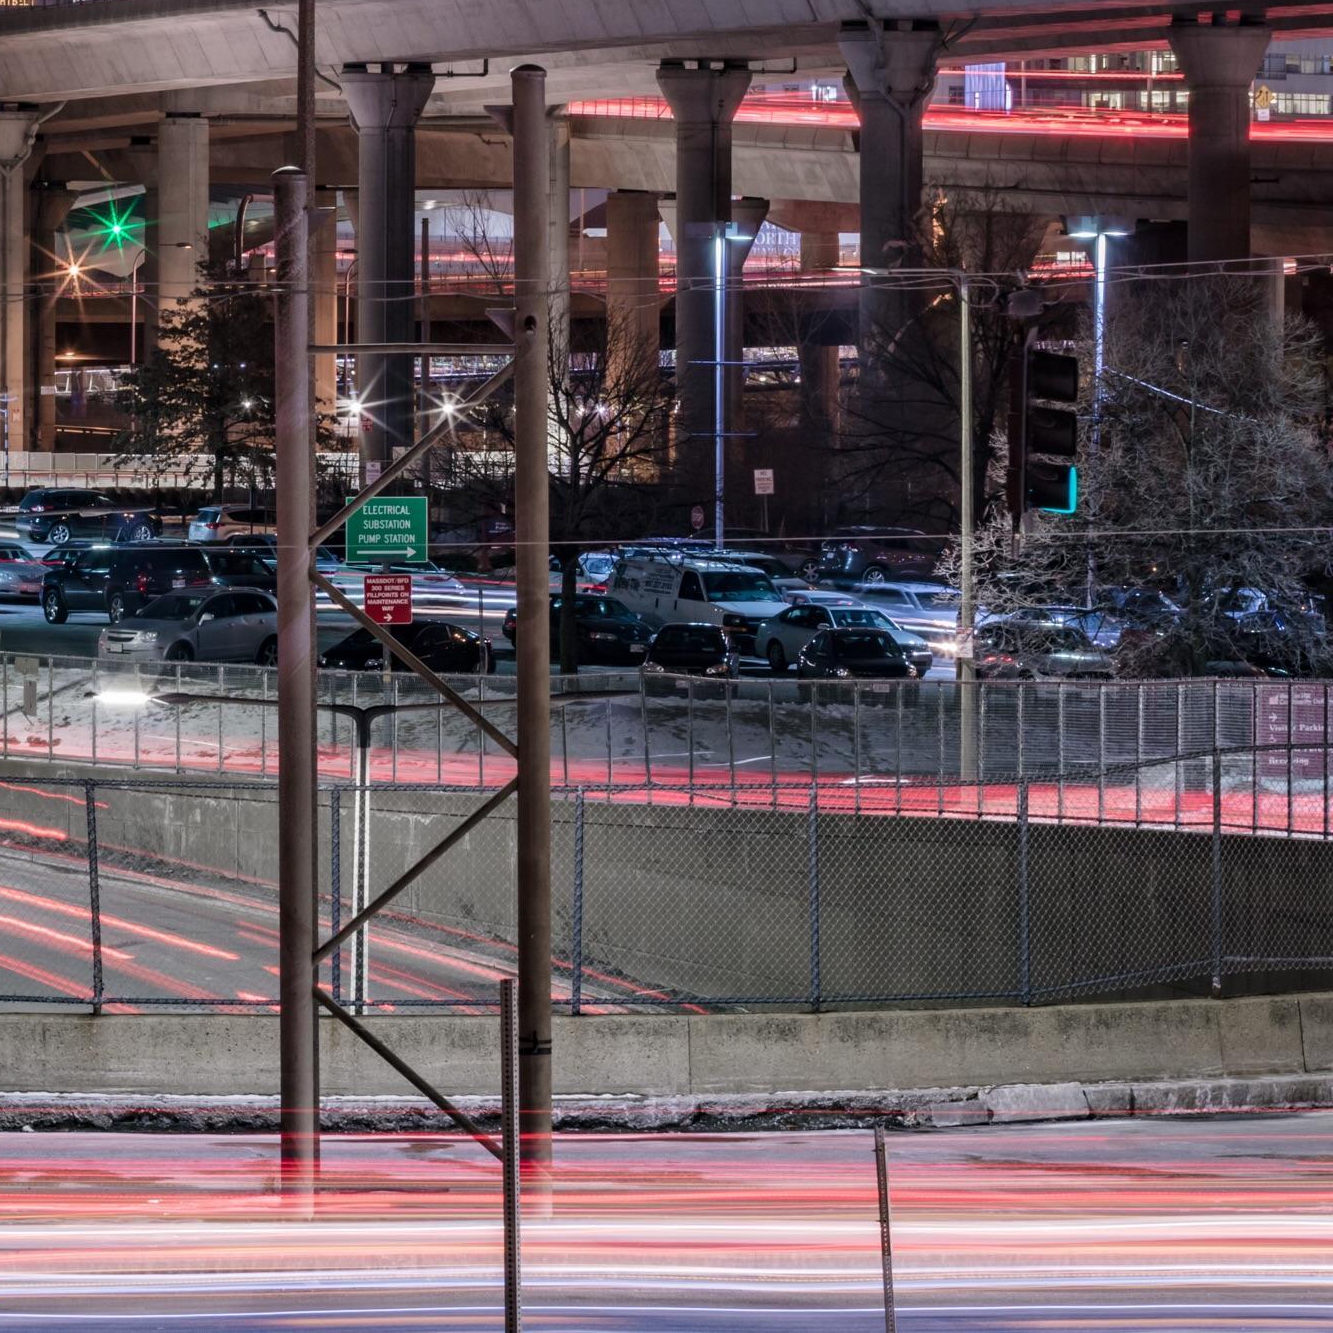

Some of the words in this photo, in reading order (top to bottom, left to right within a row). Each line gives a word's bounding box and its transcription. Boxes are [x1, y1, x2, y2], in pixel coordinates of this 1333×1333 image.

[755, 232, 797, 245] ORTH
[362, 505, 411, 515] ELECTRICAL
[363, 519, 411, 529] SUBSTATION
[358, 534, 381, 543] PUMP
[383, 534, 415, 543] STATION
[1269, 724, 1296, 732] Visitr
